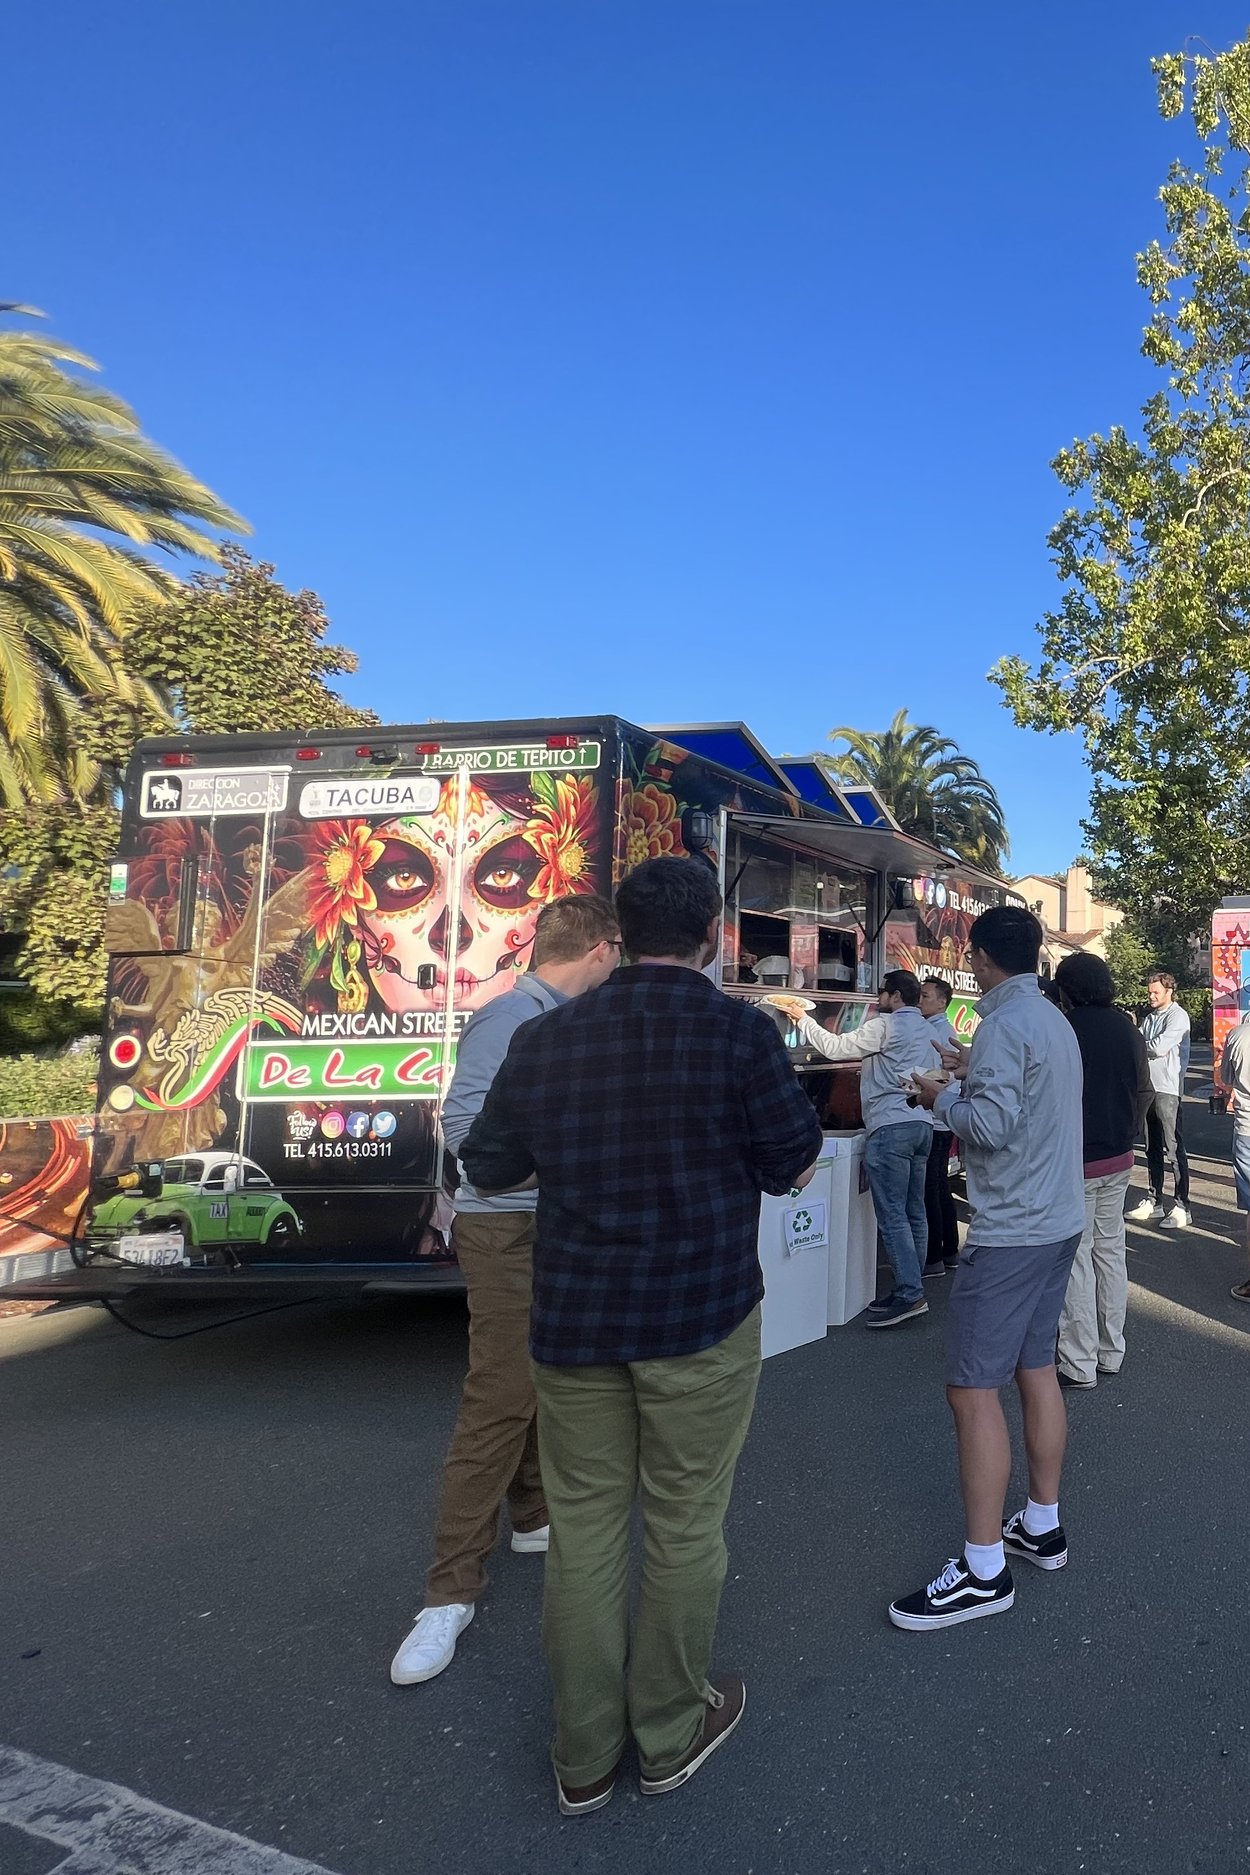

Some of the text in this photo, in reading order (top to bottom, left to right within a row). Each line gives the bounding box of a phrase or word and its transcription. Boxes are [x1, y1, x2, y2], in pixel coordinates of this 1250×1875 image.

[496, 751, 517, 768] DE
[521, 748, 576, 766] TEPITO
[186, 790, 281, 809] ZARAGOZA
[326, 786, 415, 807] TACUBA
[301, 1010, 474, 1037] MEXICAN STREET
[259, 1047, 455, 1089] De La Ca
[287, 1110, 318, 1131] Follow
[283, 1141, 392, 1158] TEL 415.613.0311
